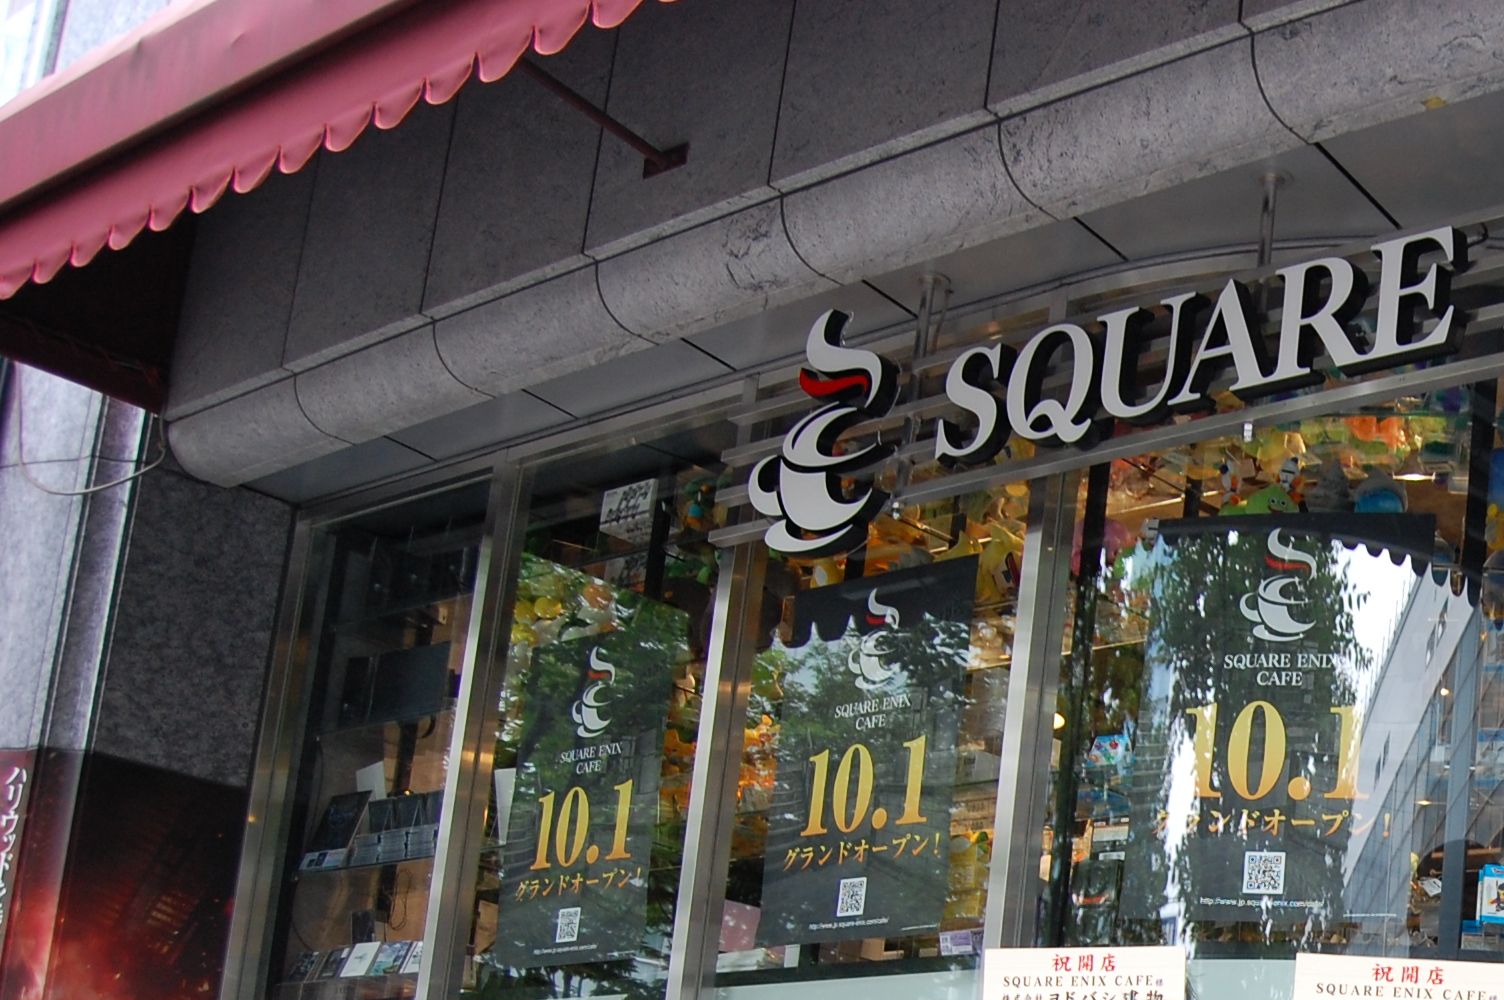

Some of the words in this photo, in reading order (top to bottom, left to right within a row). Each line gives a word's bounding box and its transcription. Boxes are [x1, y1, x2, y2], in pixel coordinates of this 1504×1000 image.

[934, 225, 1456, 461] SQUARE
[1223, 653, 1290, 669] SQUARE
[1297, 654, 1340, 669] ENIX
[1256, 671, 1302, 687] CAFE
[834, 697, 879, 719] SQUARE
[882, 694, 912, 710] ENIX
[855, 714, 886, 731] CAFE
[559, 746, 597, 764] SQUARE
[598, 742, 622, 757] ENIX
[1183, 700, 1369, 801] 10.1
[575, 760, 600, 776] CAFE
[800, 735, 928, 837] 10.1
[530, 778, 634, 871] 10.1
[783, 832, 942, 873] グランドオープン！
[1053, 953, 1117, 973] 祝開店
[1003, 976, 1063, 988] SQUARE
[1071, 976, 1106, 988] ENIX
[1372, 963, 1445, 986] 祝開店
[1316, 982, 1384, 998] SQUARE
[1393, 987, 1433, 1000] ENIX
